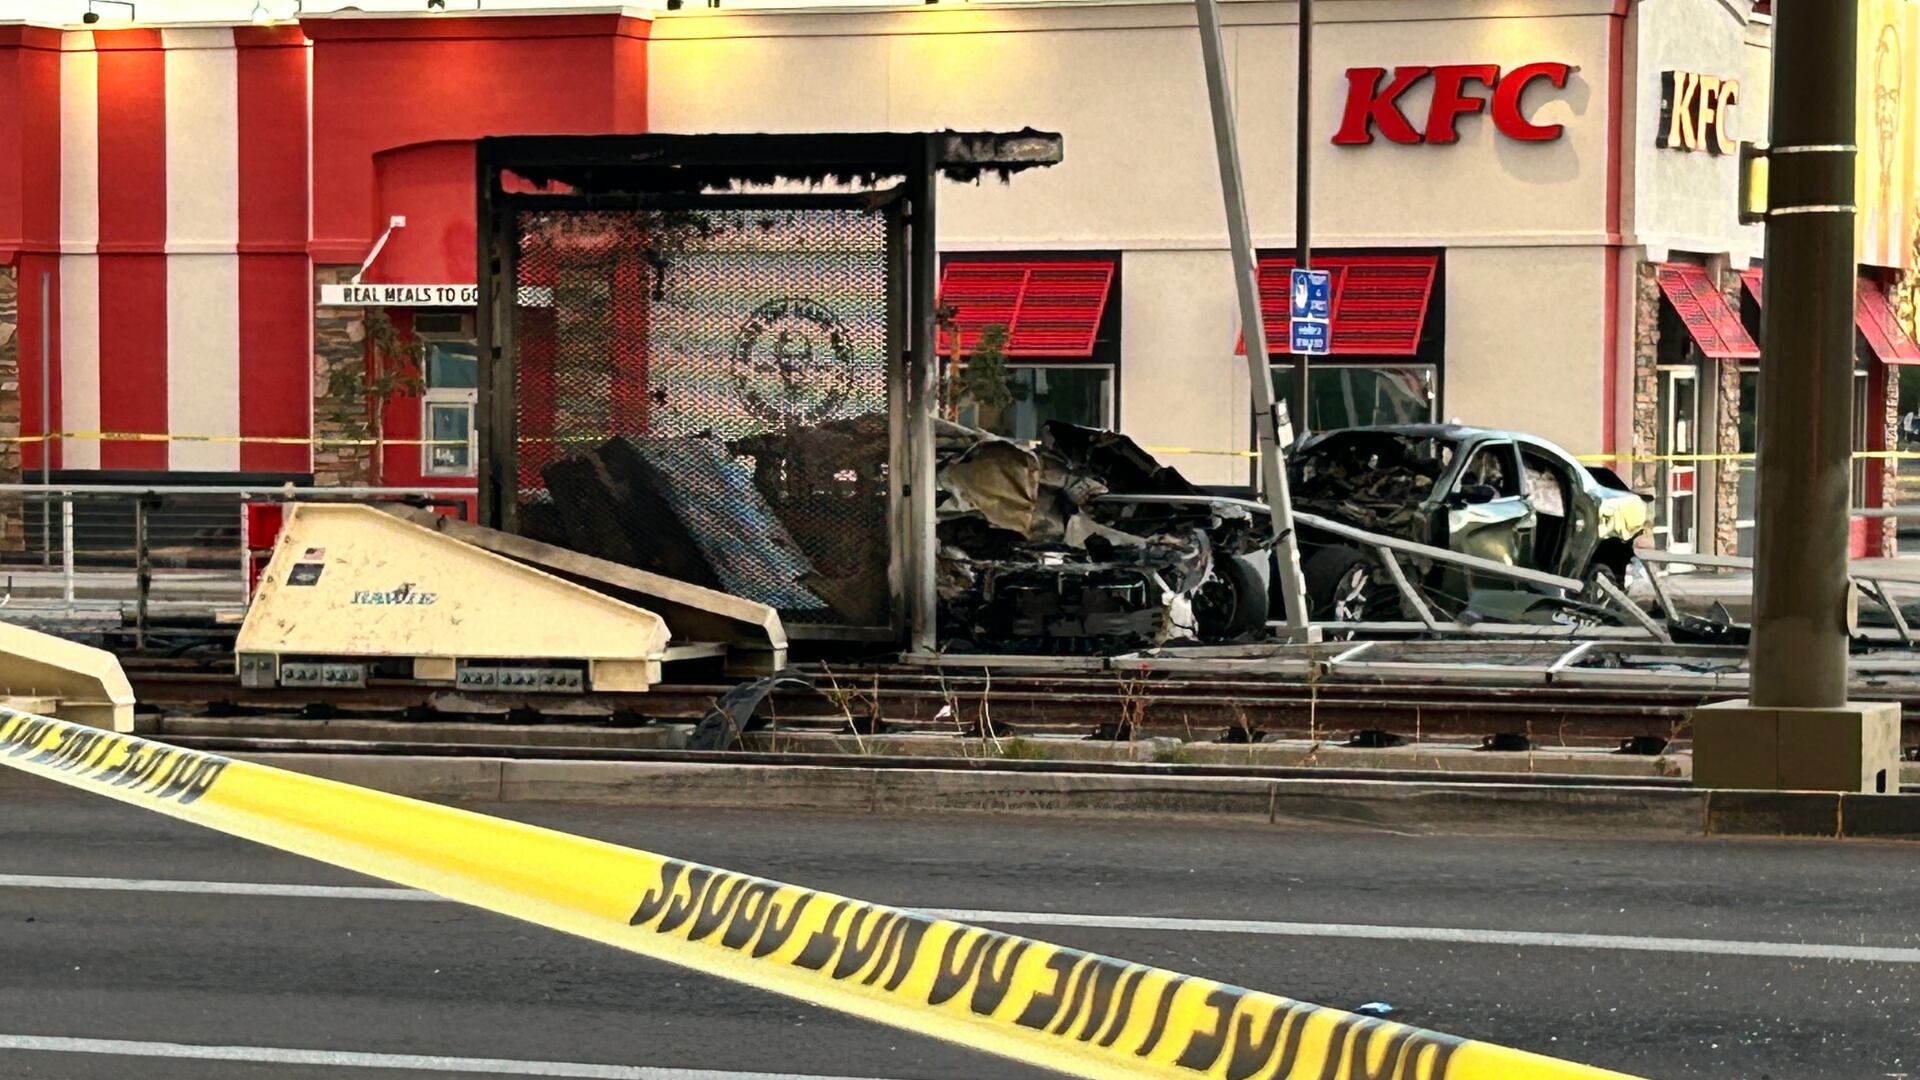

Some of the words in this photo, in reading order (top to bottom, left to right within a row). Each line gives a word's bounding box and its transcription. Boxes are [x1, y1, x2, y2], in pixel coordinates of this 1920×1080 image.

[1331, 61, 1571, 146] KFC
[1656, 70, 1740, 157] KFC
[343, 286, 380, 304] REAL
[384, 286, 432, 303] MEALS
[436, 286, 456, 303] TO
[350, 588, 438, 605] RAWIE
[629, 860, 815, 958] CROSS
[791, 898, 935, 992] NOT
[927, 925, 1036, 1016] DO
[1174, 988, 1470, 1080] ICE
